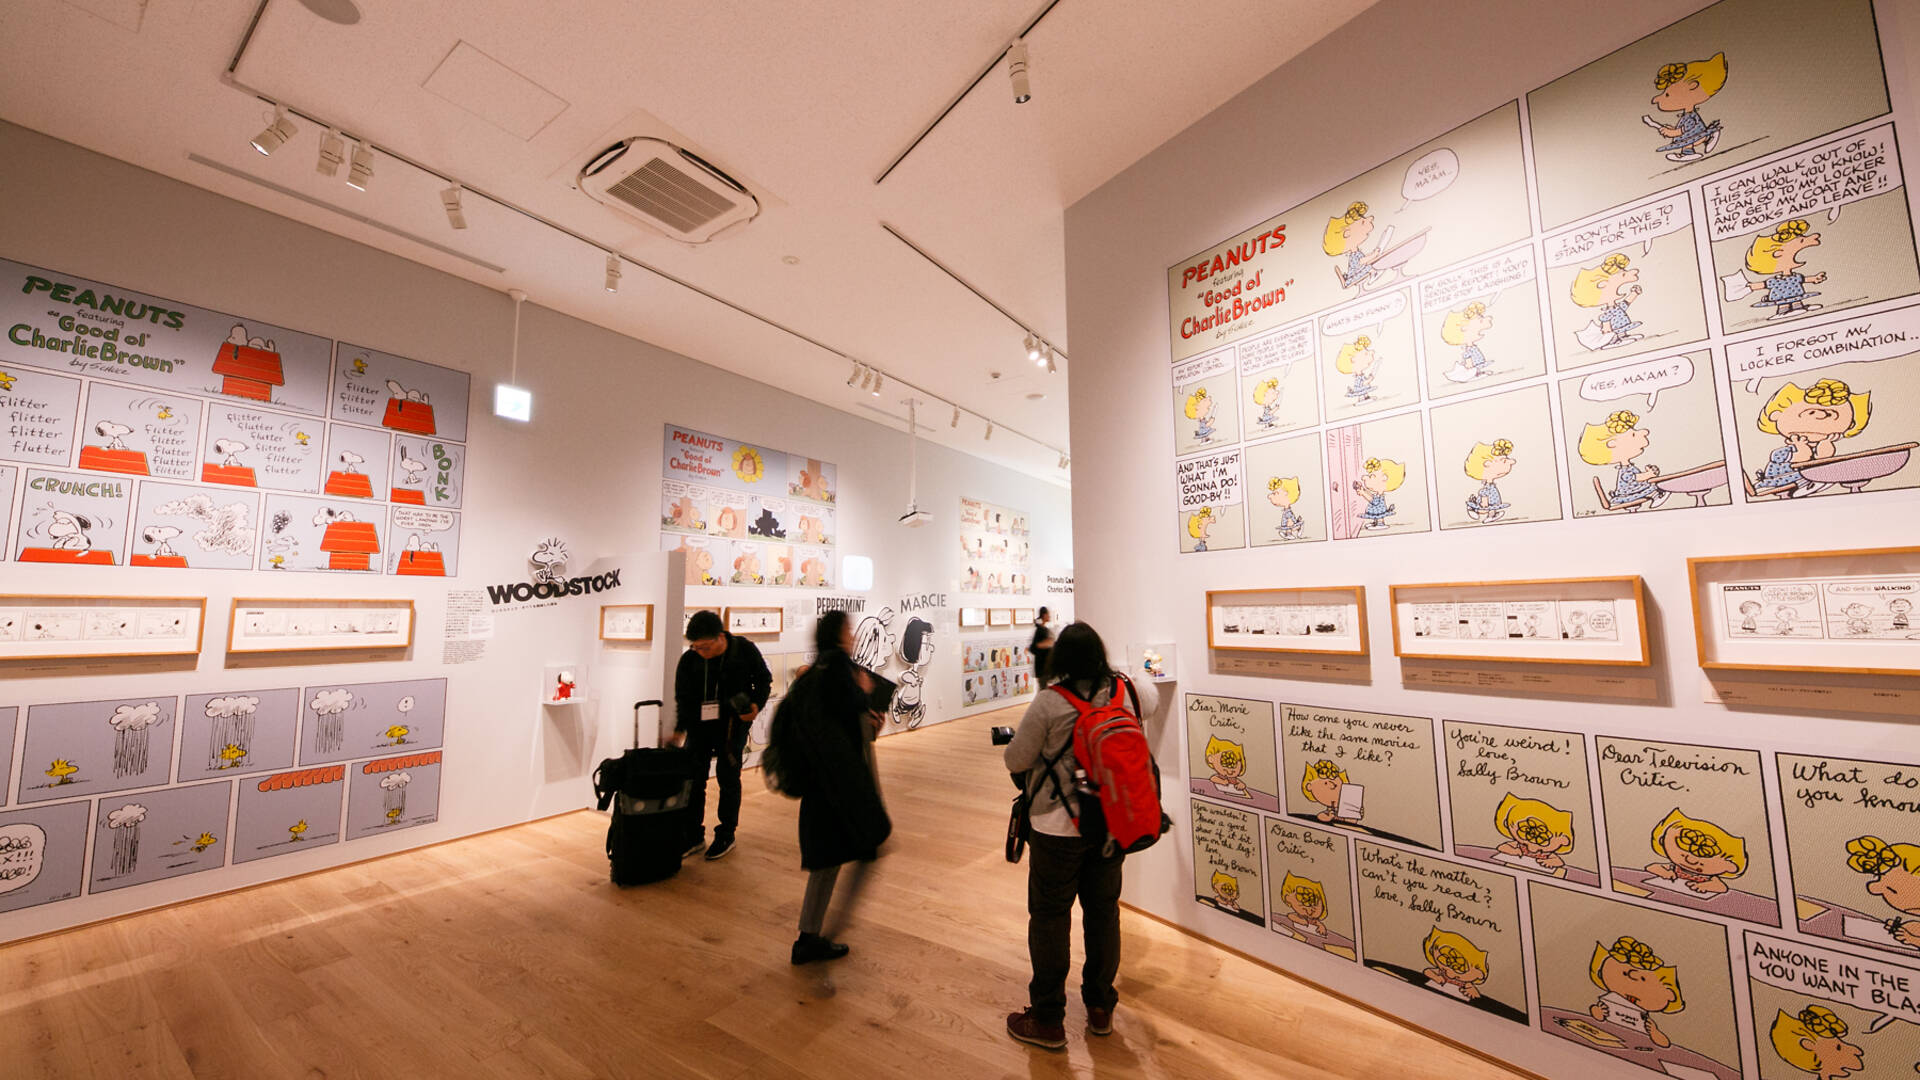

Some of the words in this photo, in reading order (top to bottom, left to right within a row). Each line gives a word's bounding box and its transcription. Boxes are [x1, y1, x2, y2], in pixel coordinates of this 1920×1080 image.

[1711, 193, 1740, 207] THIS
[1743, 177, 1798, 199] SCHOOL,
[1801, 164, 1826, 177] YOU
[1832, 142, 1885, 170] KNOW!
[1714, 186, 1721, 196] I
[1728, 176, 1756, 193] CAN
[1762, 162, 1805, 182] WALK
[1812, 147, 1842, 165] OUT
[1845, 139, 1866, 155] OF
[1714, 207, 1721, 216] I
[1726, 199, 1753, 213] CAN
[1758, 191, 1775, 203] GO
[1778, 184, 1795, 197] TO
[1799, 178, 1818, 191] MY
[1824, 157, 1886, 182] LOCKER
[1714, 212, 1741, 227] AND
[1746, 203, 1769, 217] GET
[1776, 194, 1798, 208] MY
[1802, 183, 1839, 201] COAT
[1845, 170, 1878, 188] AND
[1561, 238, 1568, 249] I
[1574, 223, 1612, 244] DON'T
[1618, 211, 1652, 229] HAVE
[1655, 204, 1674, 216] TO
[1716, 223, 1735, 235] MY
[1742, 209, 1784, 227] BOOKS
[1788, 199, 1818, 215] AND
[1182, 224, 1287, 289] PEANUTS
[1554, 241, 1595, 262] STAND
[1600, 231, 1624, 246] FOR
[22, 275, 186, 331] PEANUTS
[76, 308, 125, 329] featuring
[1756, 346, 1764, 357] I
[1776, 332, 1840, 352] FORGOT
[1845, 323, 1873, 338] MY
[1740, 353, 1795, 373] LOCKER
[340, 392, 376, 405] flitter
[346, 381, 380, 396] flitter
[9, 411, 61, 425] flitter
[227, 412, 263, 424] flitter
[342, 404, 375, 417] flitter
[8, 425, 63, 439] flitter
[145, 423, 185, 437] flitter
[237, 422, 274, 432] flutter
[250, 432, 285, 442] flutter
[11, 440, 65, 455] flutter
[150, 435, 187, 447] flitter
[154, 445, 192, 457] flutter
[255, 443, 287, 453] flitter
[672, 430, 725, 453] PEANUTS
[153, 456, 193, 467] flutter
[264, 464, 301, 475] flutter
[265, 453, 303, 464] flitter
[1178, 462, 1195, 477] AND
[1221, 453, 1240, 466] JUST
[155, 466, 189, 477] flitter
[432, 443, 453, 502] BONK
[1180, 471, 1207, 485] WHAT
[1212, 467, 1228, 479] I'M
[30, 477, 123, 498] CRUNCH!
[1182, 481, 1218, 495] GONNA
[1220, 474, 1238, 489] DO!
[486, 567, 622, 606] WOODSTOCK
[816, 597, 866, 615] PEPPERMINT
[900, 593, 947, 614] MARCIE
[1189, 698, 1217, 714] Dear
[1218, 700, 1250, 716] Movie
[1286, 707, 1309, 722] How
[1313, 713, 1340, 725] come
[1343, 716, 1369, 730] you
[1372, 720, 1415, 733] never
[1288, 725, 1314, 738] like
[1317, 728, 1337, 742] the
[1340, 734, 1369, 744] same
[1371, 736, 1421, 750] movies
[1301, 740, 1327, 755] that
[1450, 727, 1499, 750] You're
[1601, 744, 1644, 764] Dear
[1642, 746, 1750, 777] Television
[1456, 759, 1502, 786] Sally
[1505, 767, 1572, 790] Brown
[1793, 761, 1867, 785] What
[1883, 772, 1919, 789] do
[1796, 786, 1843, 809] you
[1270, 823, 1300, 840] Dear
[1303, 830, 1336, 853] Book
[1359, 846, 1405, 871] What's
[1405, 859, 1428, 877] the
[1361, 866, 1398, 885] can't
[1402, 878, 1429, 895] you
[1408, 894, 1444, 923] Sally
[1446, 902, 1502, 934] Brown
[1752, 940, 1829, 975] ANYONE
[1838, 963, 1860, 983] IN
[1865, 968, 1910, 993] THE
[1759, 960, 1796, 983] YOU
[1802, 970, 1859, 1000] WANT
